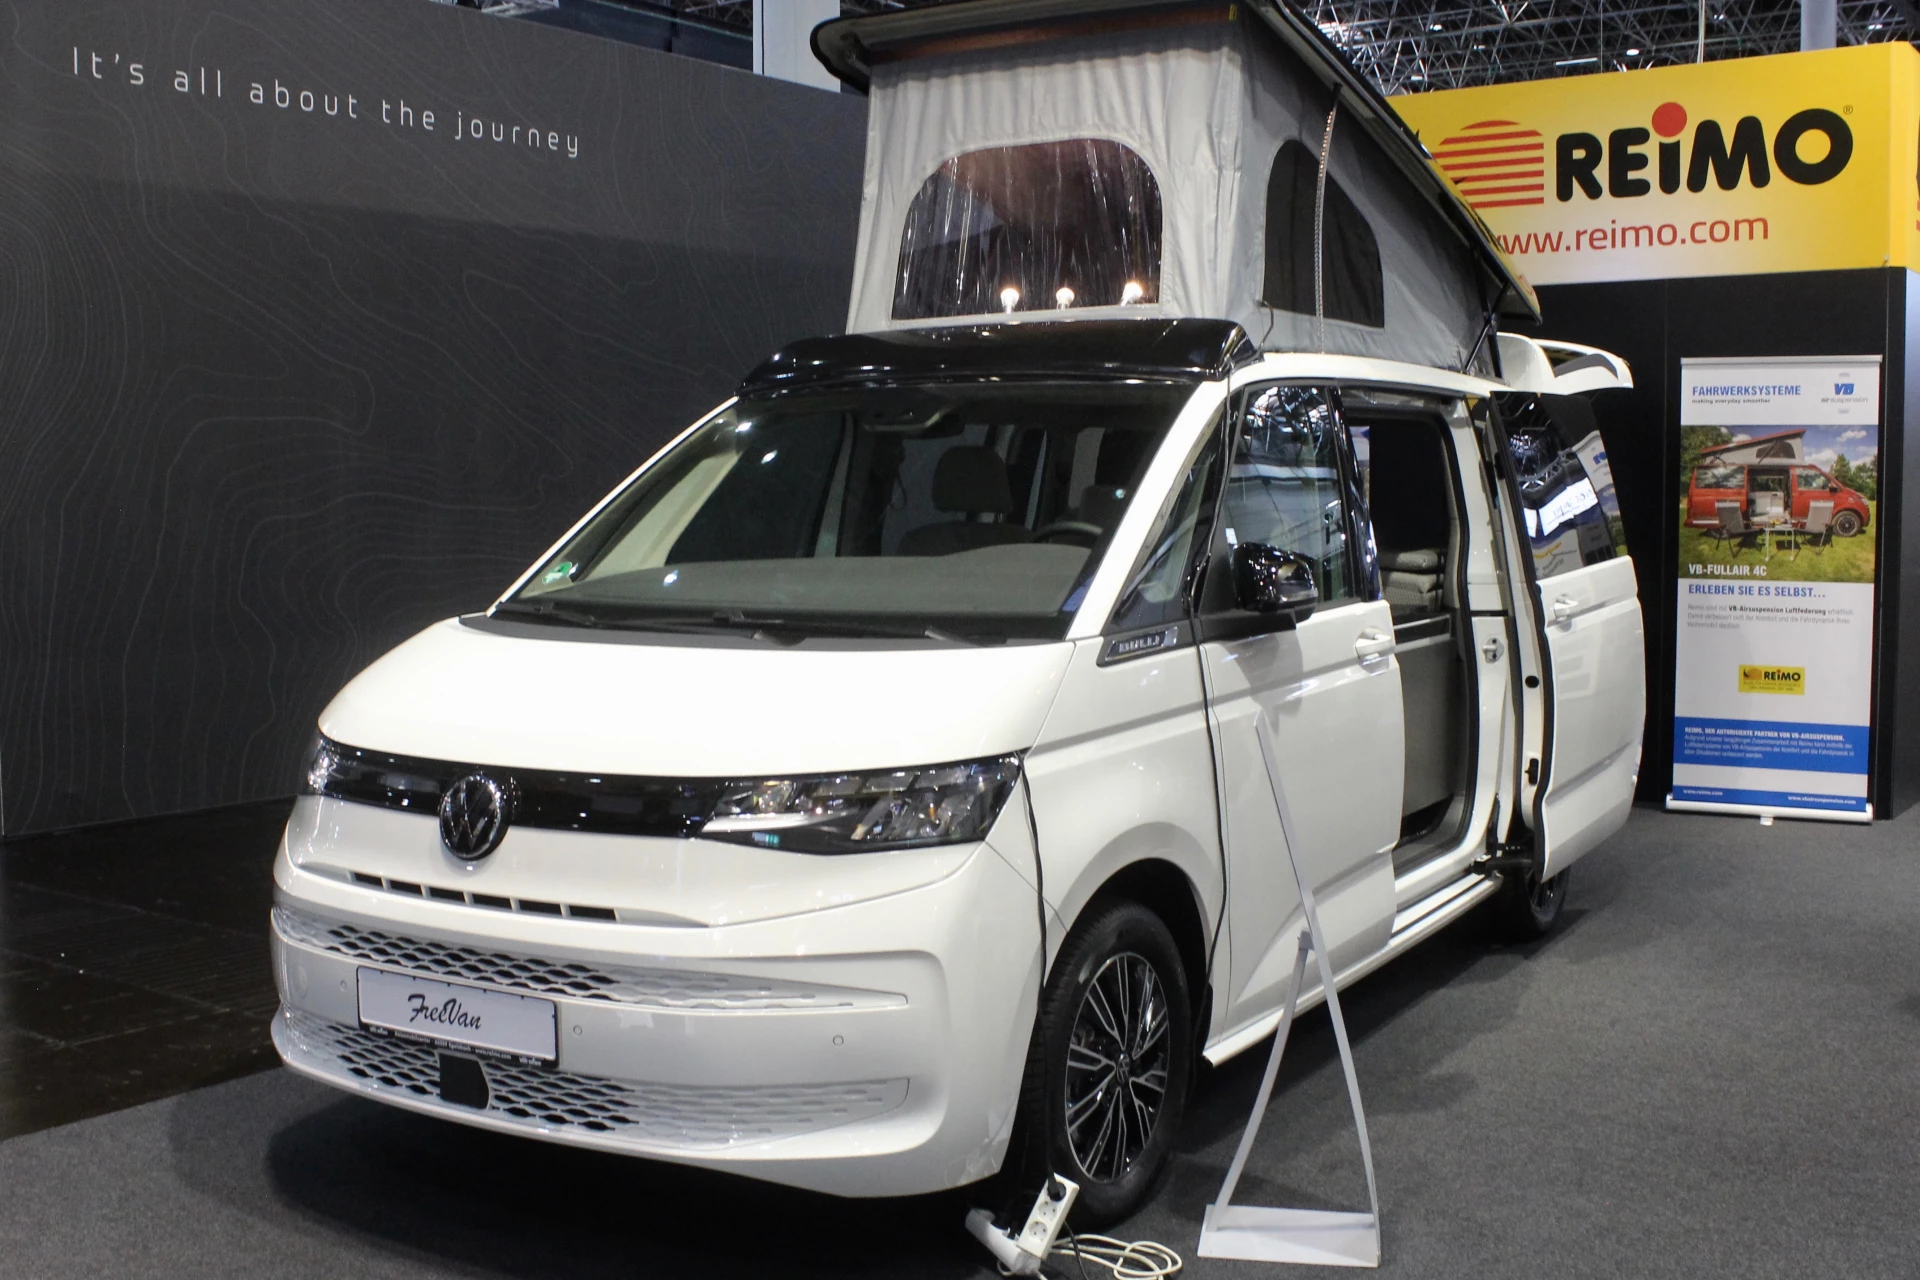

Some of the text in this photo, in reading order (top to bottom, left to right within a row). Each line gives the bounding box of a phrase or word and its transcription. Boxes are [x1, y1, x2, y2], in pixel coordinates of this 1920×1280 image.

[73, 46, 579, 159] It's all about the journey
[1497, 216, 1770, 256] ww.reimo.com
[1691, 384, 1802, 397] FAHRWERKSYSTEME
[1714, 397, 1741, 405] everyday
[1688, 563, 1768, 577] VB-FULLAIR 4C
[1688, 583, 1735, 596] ERLEBEN
[1738, 585, 1755, 597] SIE
[1758, 586, 1771, 597] ES
[1785, 607, 1827, 616] Luftfederung
[407, 993, 482, 1031] FreeVan
